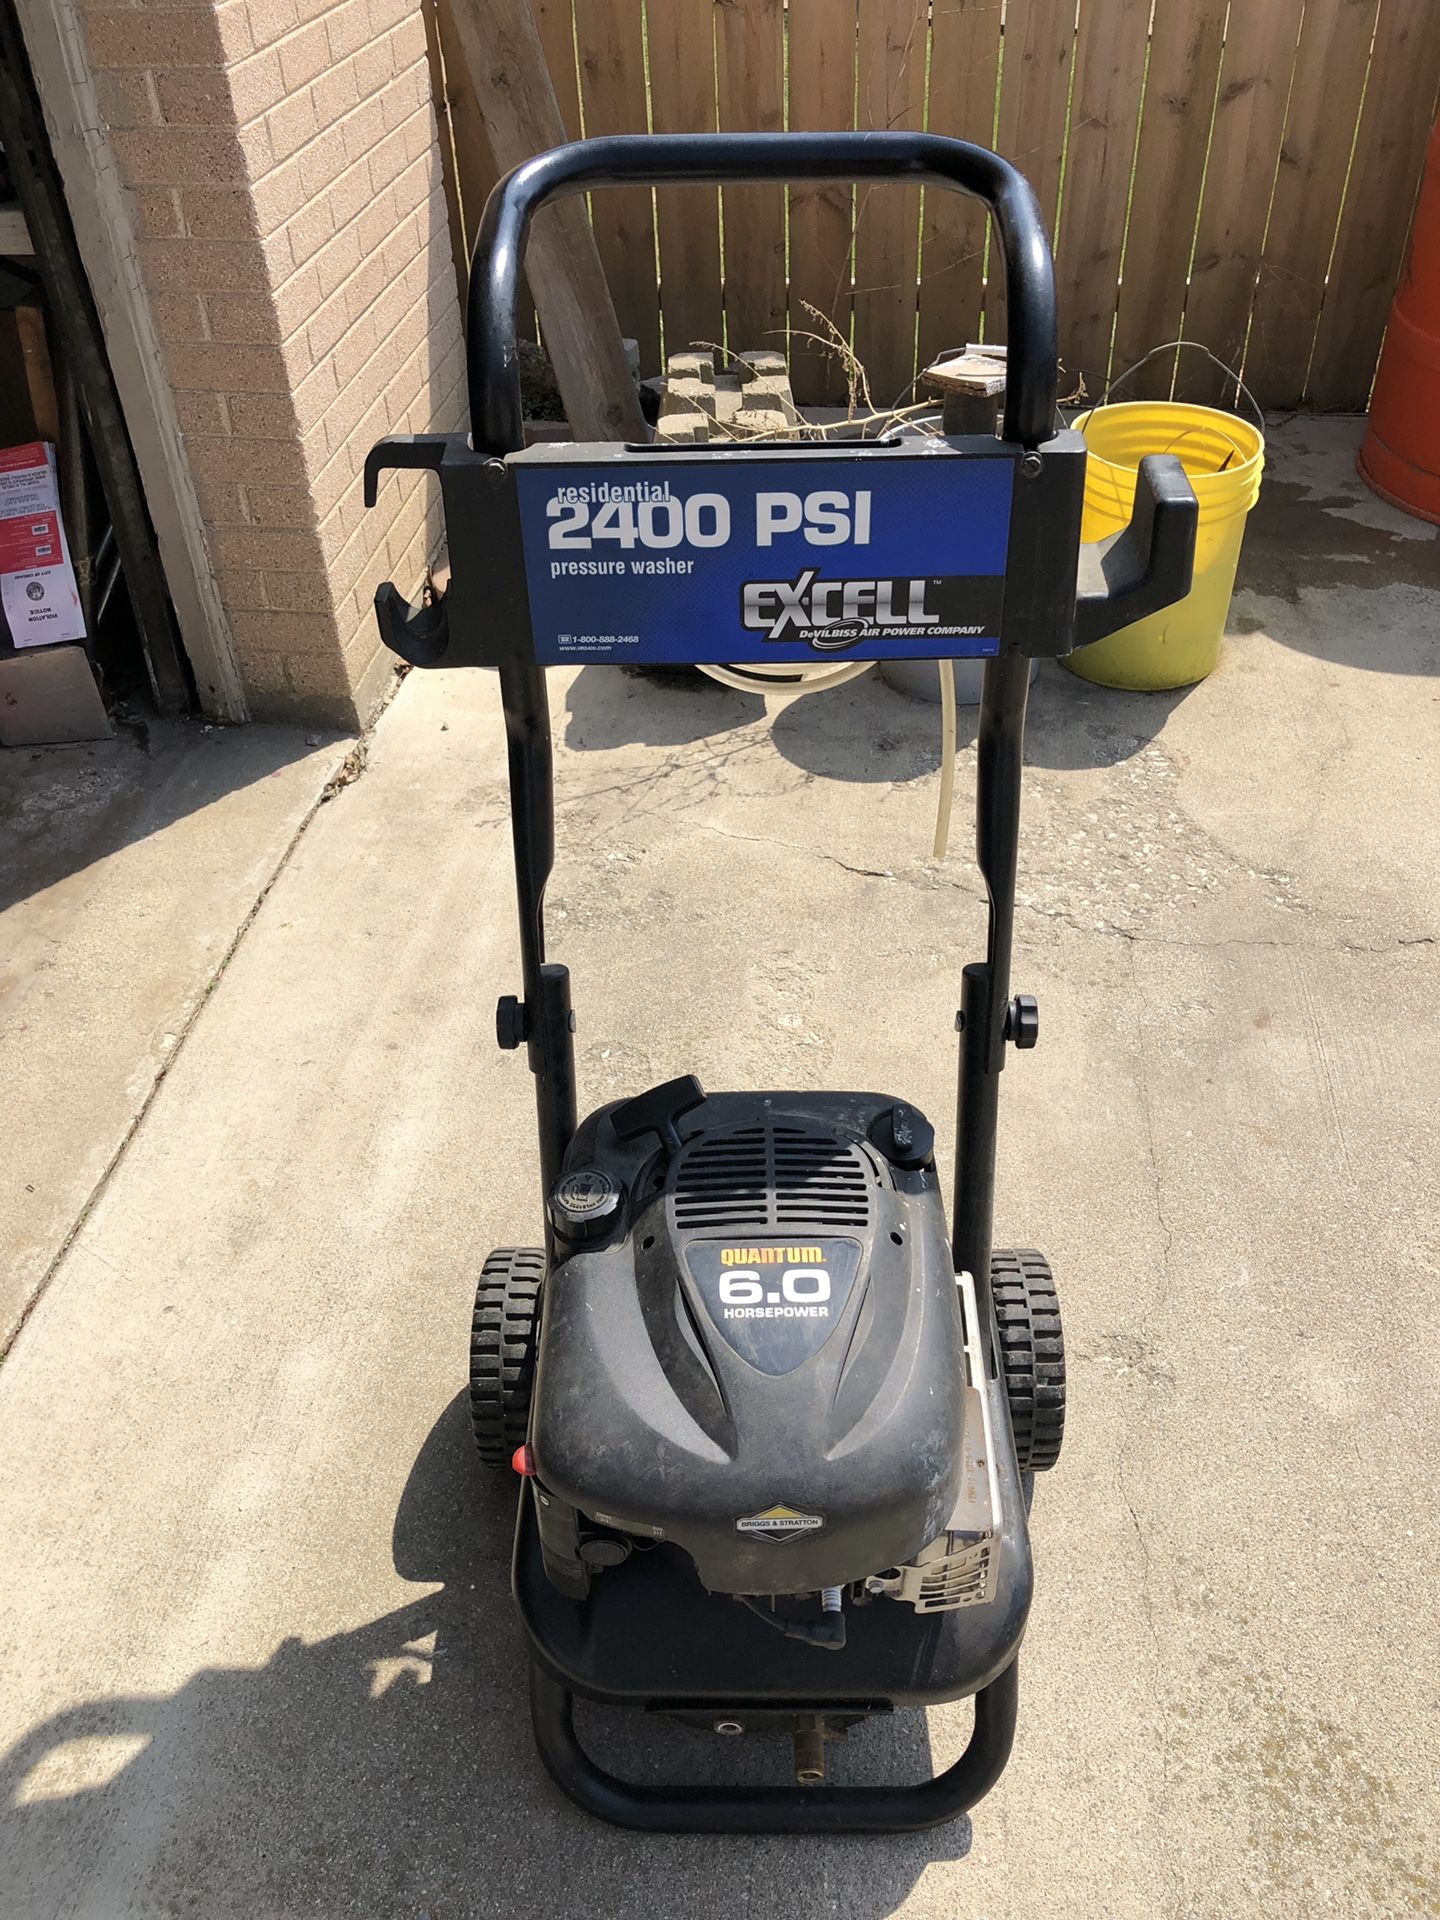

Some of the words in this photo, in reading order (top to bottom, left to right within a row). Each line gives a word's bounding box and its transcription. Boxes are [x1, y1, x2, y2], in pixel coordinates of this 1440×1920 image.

[557, 481, 671, 503] residential
[546, 492, 731, 550] 2400
[756, 490, 872, 547] PSI
[551, 559, 626, 579] pressure
[631, 557, 694, 576] washer
[28, 613, 59, 622] VIOLATION
[29, 607, 52, 615] NOTICE
[572, 635, 639, 643] 1-800-888-2468
[799, 628, 858, 639] DeVILBISS
[859, 627, 880, 637] AIR
[882, 626, 925, 636] POWER
[927, 625, 986, 635] COMPANY
[721, 1247, 823, 1266] QUANTUM
[719, 1268, 831, 1304] 6.0
[724, 1306, 829, 1319] HORSEPOWER
